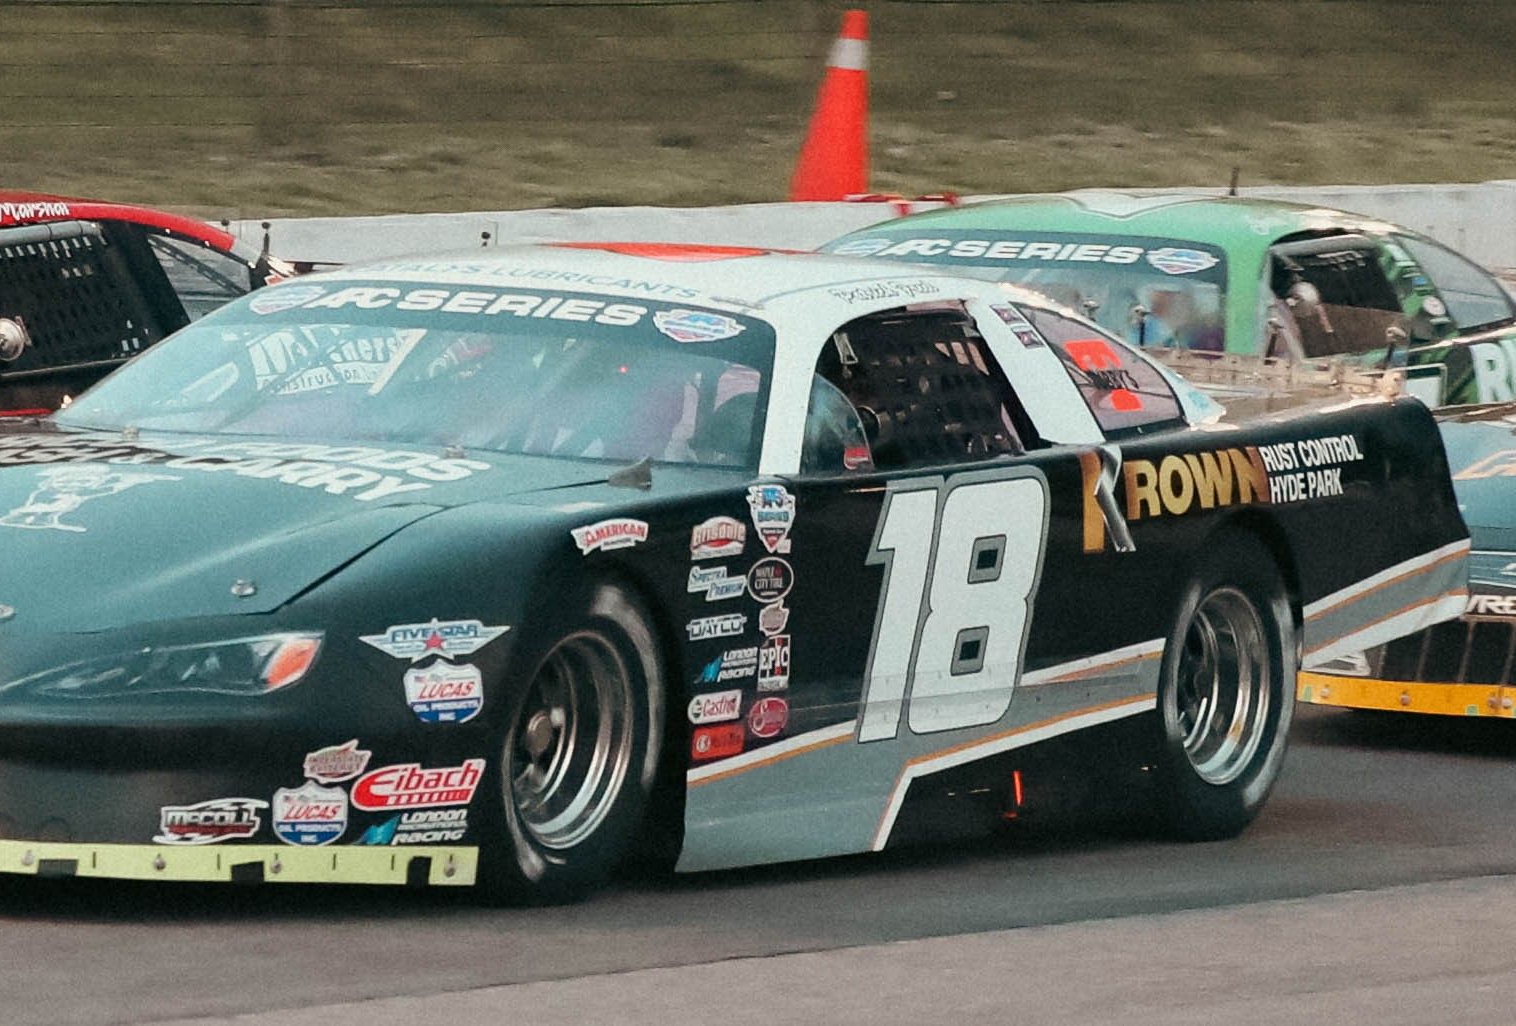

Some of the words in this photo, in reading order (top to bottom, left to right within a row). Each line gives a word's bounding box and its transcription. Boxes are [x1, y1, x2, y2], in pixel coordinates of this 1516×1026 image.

[947, 240, 1145, 264] SERIES
[490, 264, 702, 299] LUBRICANTS
[397, 288, 649, 327] SERIES
[1259, 443, 1299, 472] RUST
[1297, 435, 1364, 467] CONTROL
[165, 454, 434, 501] CARRY
[1269, 473, 1308, 504] HYDE
[1307, 467, 1344, 498] PARK
[584, 523, 646, 547] AMERICAN
[856, 470, 1048, 744] 18
[392, 628, 432, 643] FIVE
[760, 646, 789, 670] EPIC
[419, 681, 475, 700] LUCAS
[354, 762, 479, 806] Eibach
[284, 804, 342, 820] LUCAS
